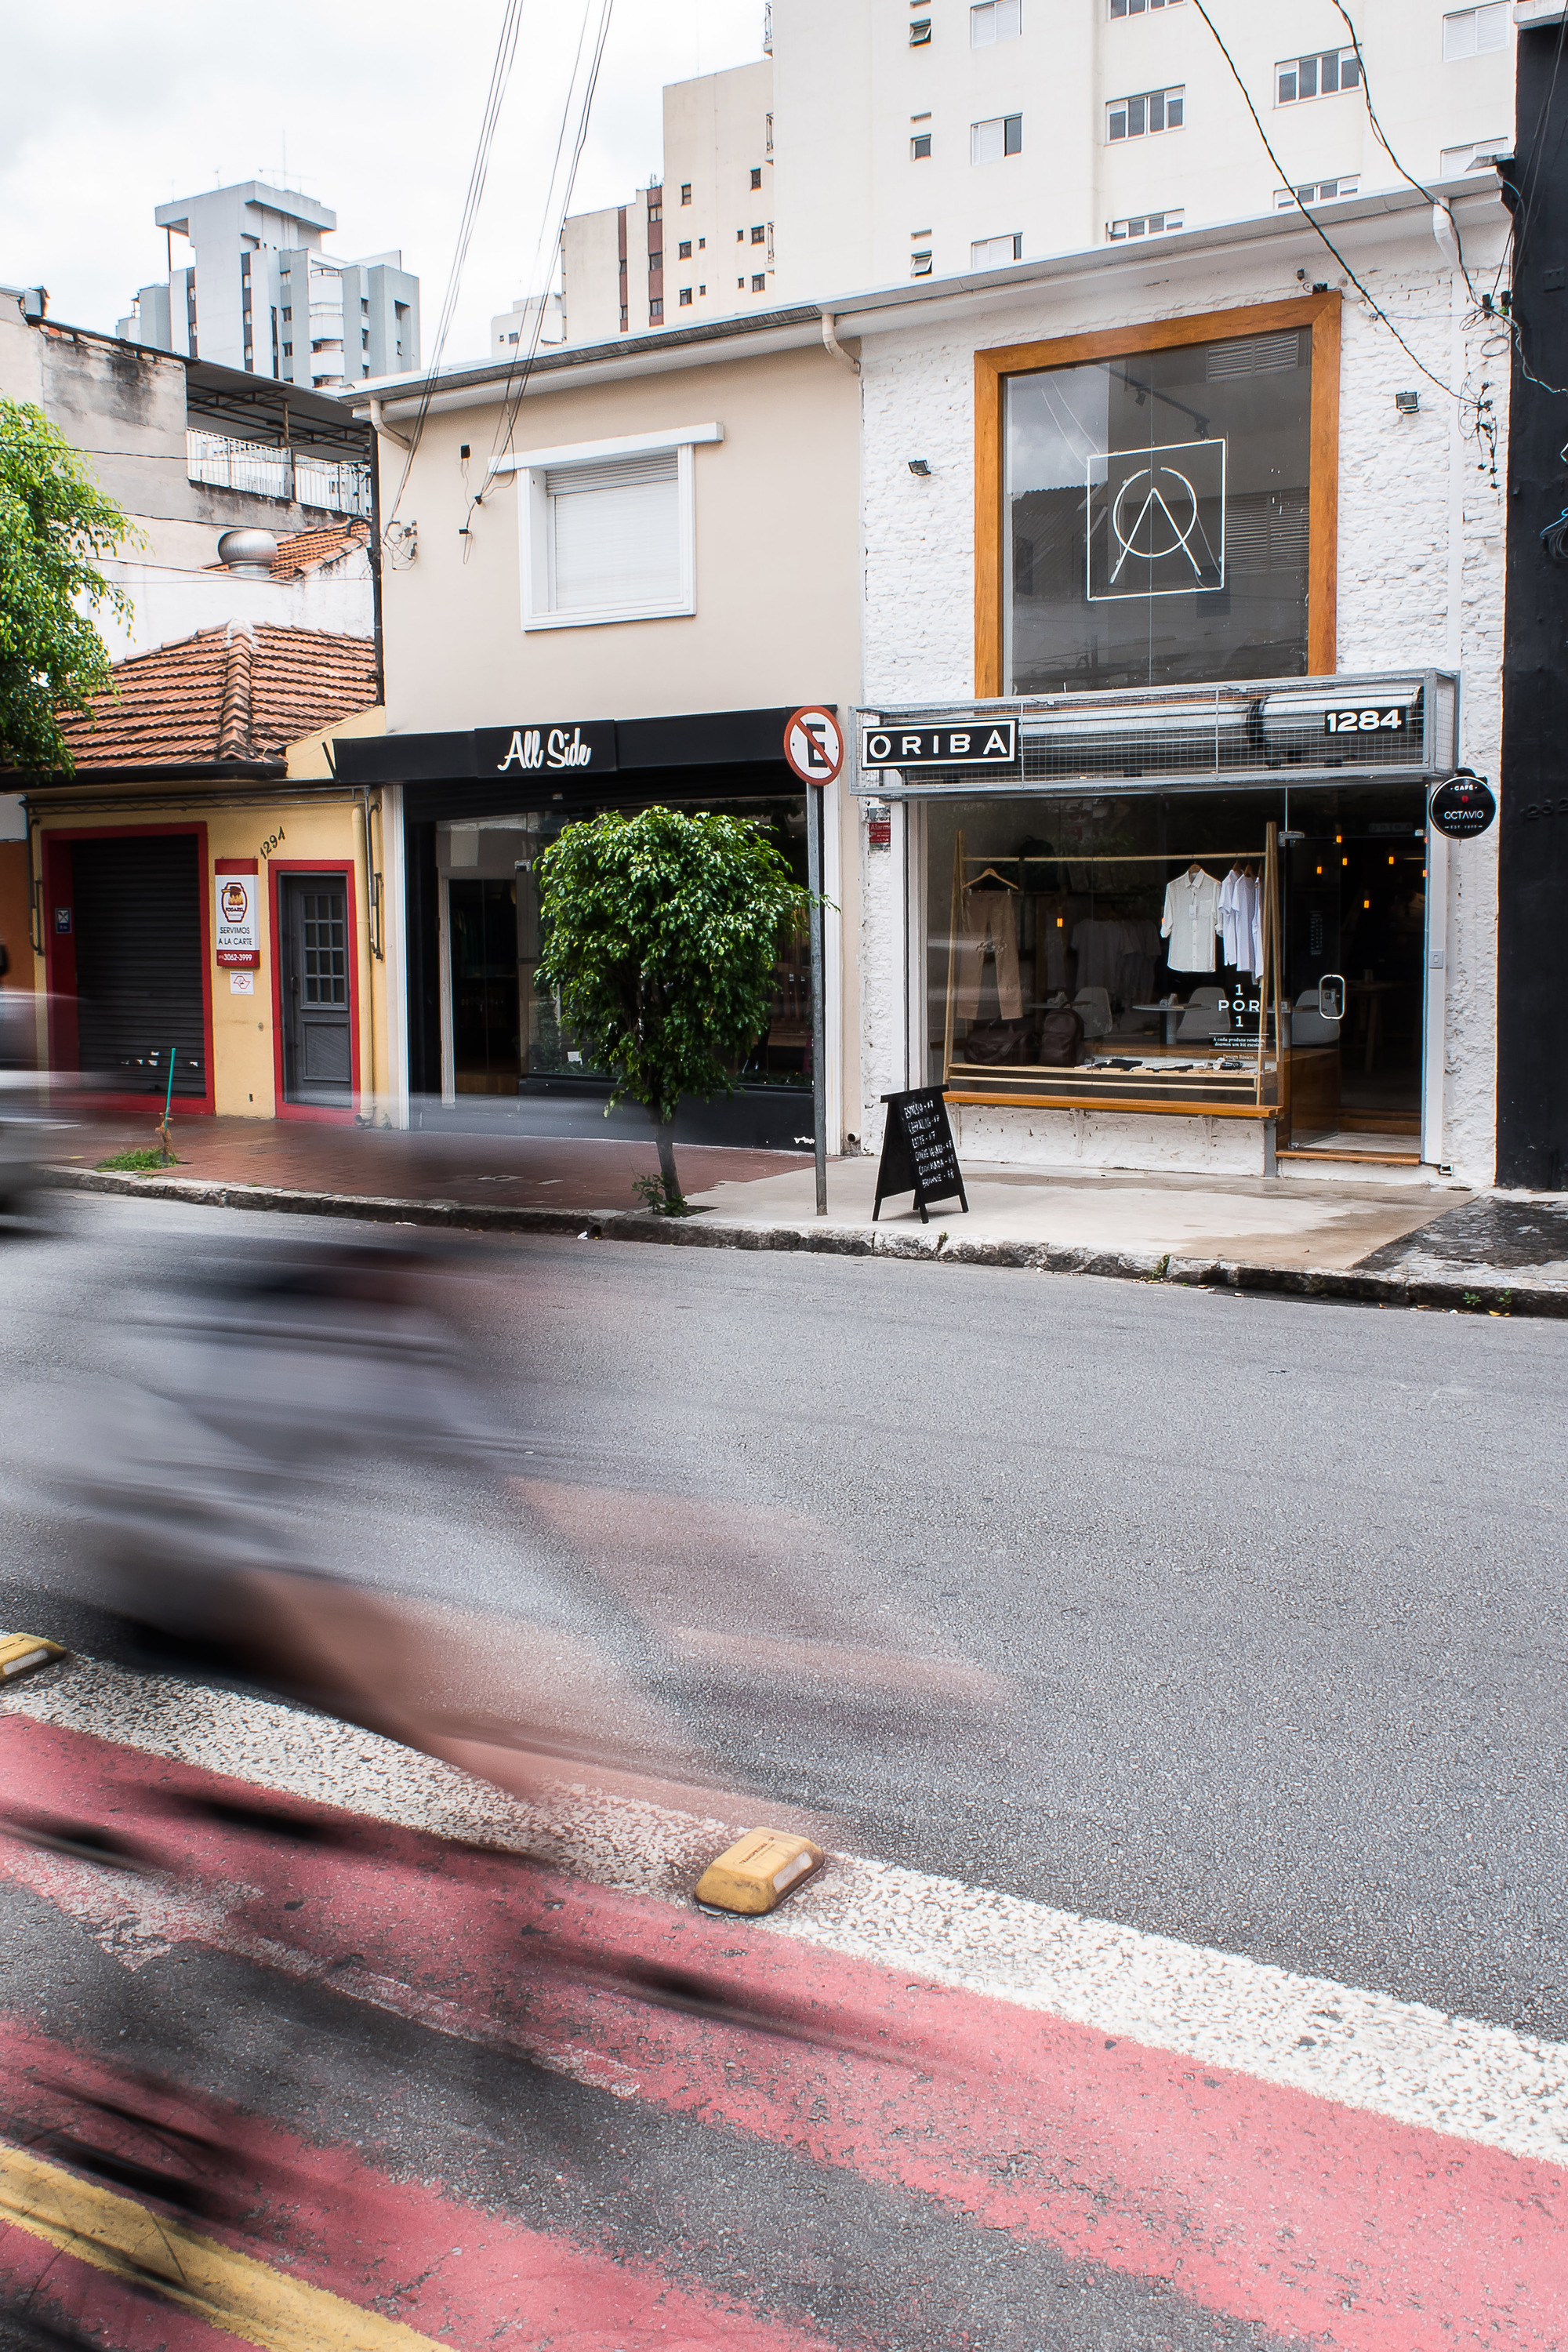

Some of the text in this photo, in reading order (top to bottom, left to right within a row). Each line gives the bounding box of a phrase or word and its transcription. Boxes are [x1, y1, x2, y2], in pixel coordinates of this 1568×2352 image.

[1327, 709, 1402, 732] 1284
[497, 728, 592, 771] All Side
[869, 729, 1007, 759] ORIBA
[1443, 810, 1484, 819] OCTAVIO
[260, 826, 285, 860] 1294
[1235, 984, 1243, 996] 1
[1218, 1000, 1260, 1011] POR
[1236, 1015, 1244, 1027] 1
